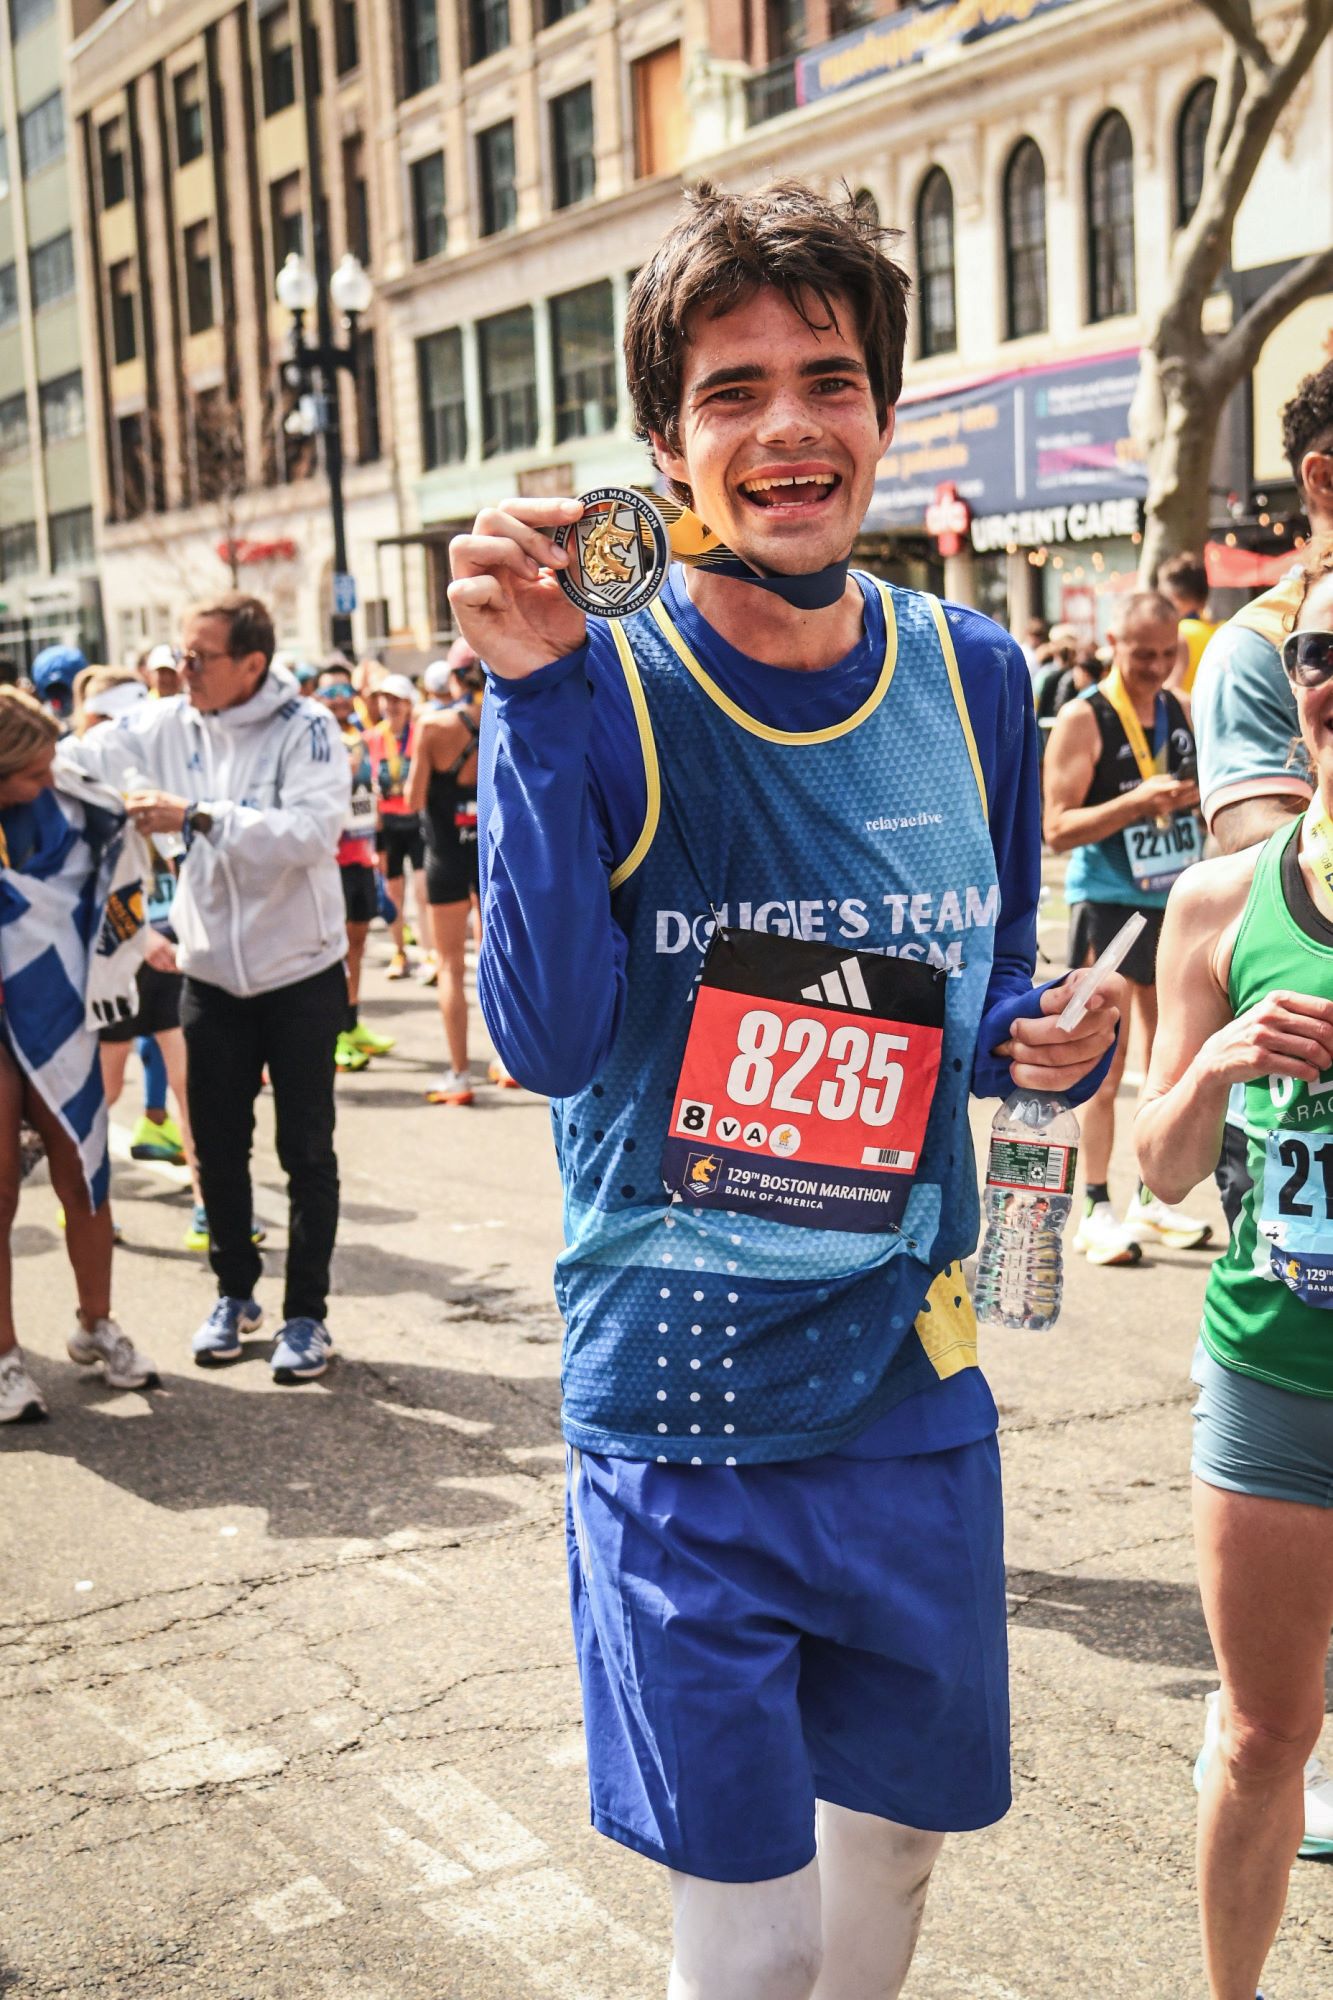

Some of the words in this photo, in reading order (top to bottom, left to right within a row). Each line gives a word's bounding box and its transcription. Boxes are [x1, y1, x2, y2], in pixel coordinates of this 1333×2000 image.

[608, 490, 659, 529] MARATHON
[971, 506, 1067, 552] URGENT
[1067, 498, 1139, 541] CARE
[562, 581, 588, 609] BOSTON
[588, 605, 625, 616] ATHLETIC
[626, 567, 663, 611] ASSOCIATION
[866, 811, 943, 832] relayactive
[883, 884, 1000, 935] TEAM
[726, 1010, 909, 1127] 8235
[682, 1104, 706, 1131] 8
[722, 1121, 738, 1137] V
[746, 1127, 762, 1143] A
[724, 1185, 757, 1199] BANK
[758, 1192, 774, 1202] OF
[775, 1195, 824, 1210] AMERICA
[727, 1167, 760, 1184] 129TH
[760, 1173, 818, 1195] BOSTON
[818, 1183, 892, 1203] MARATHON
